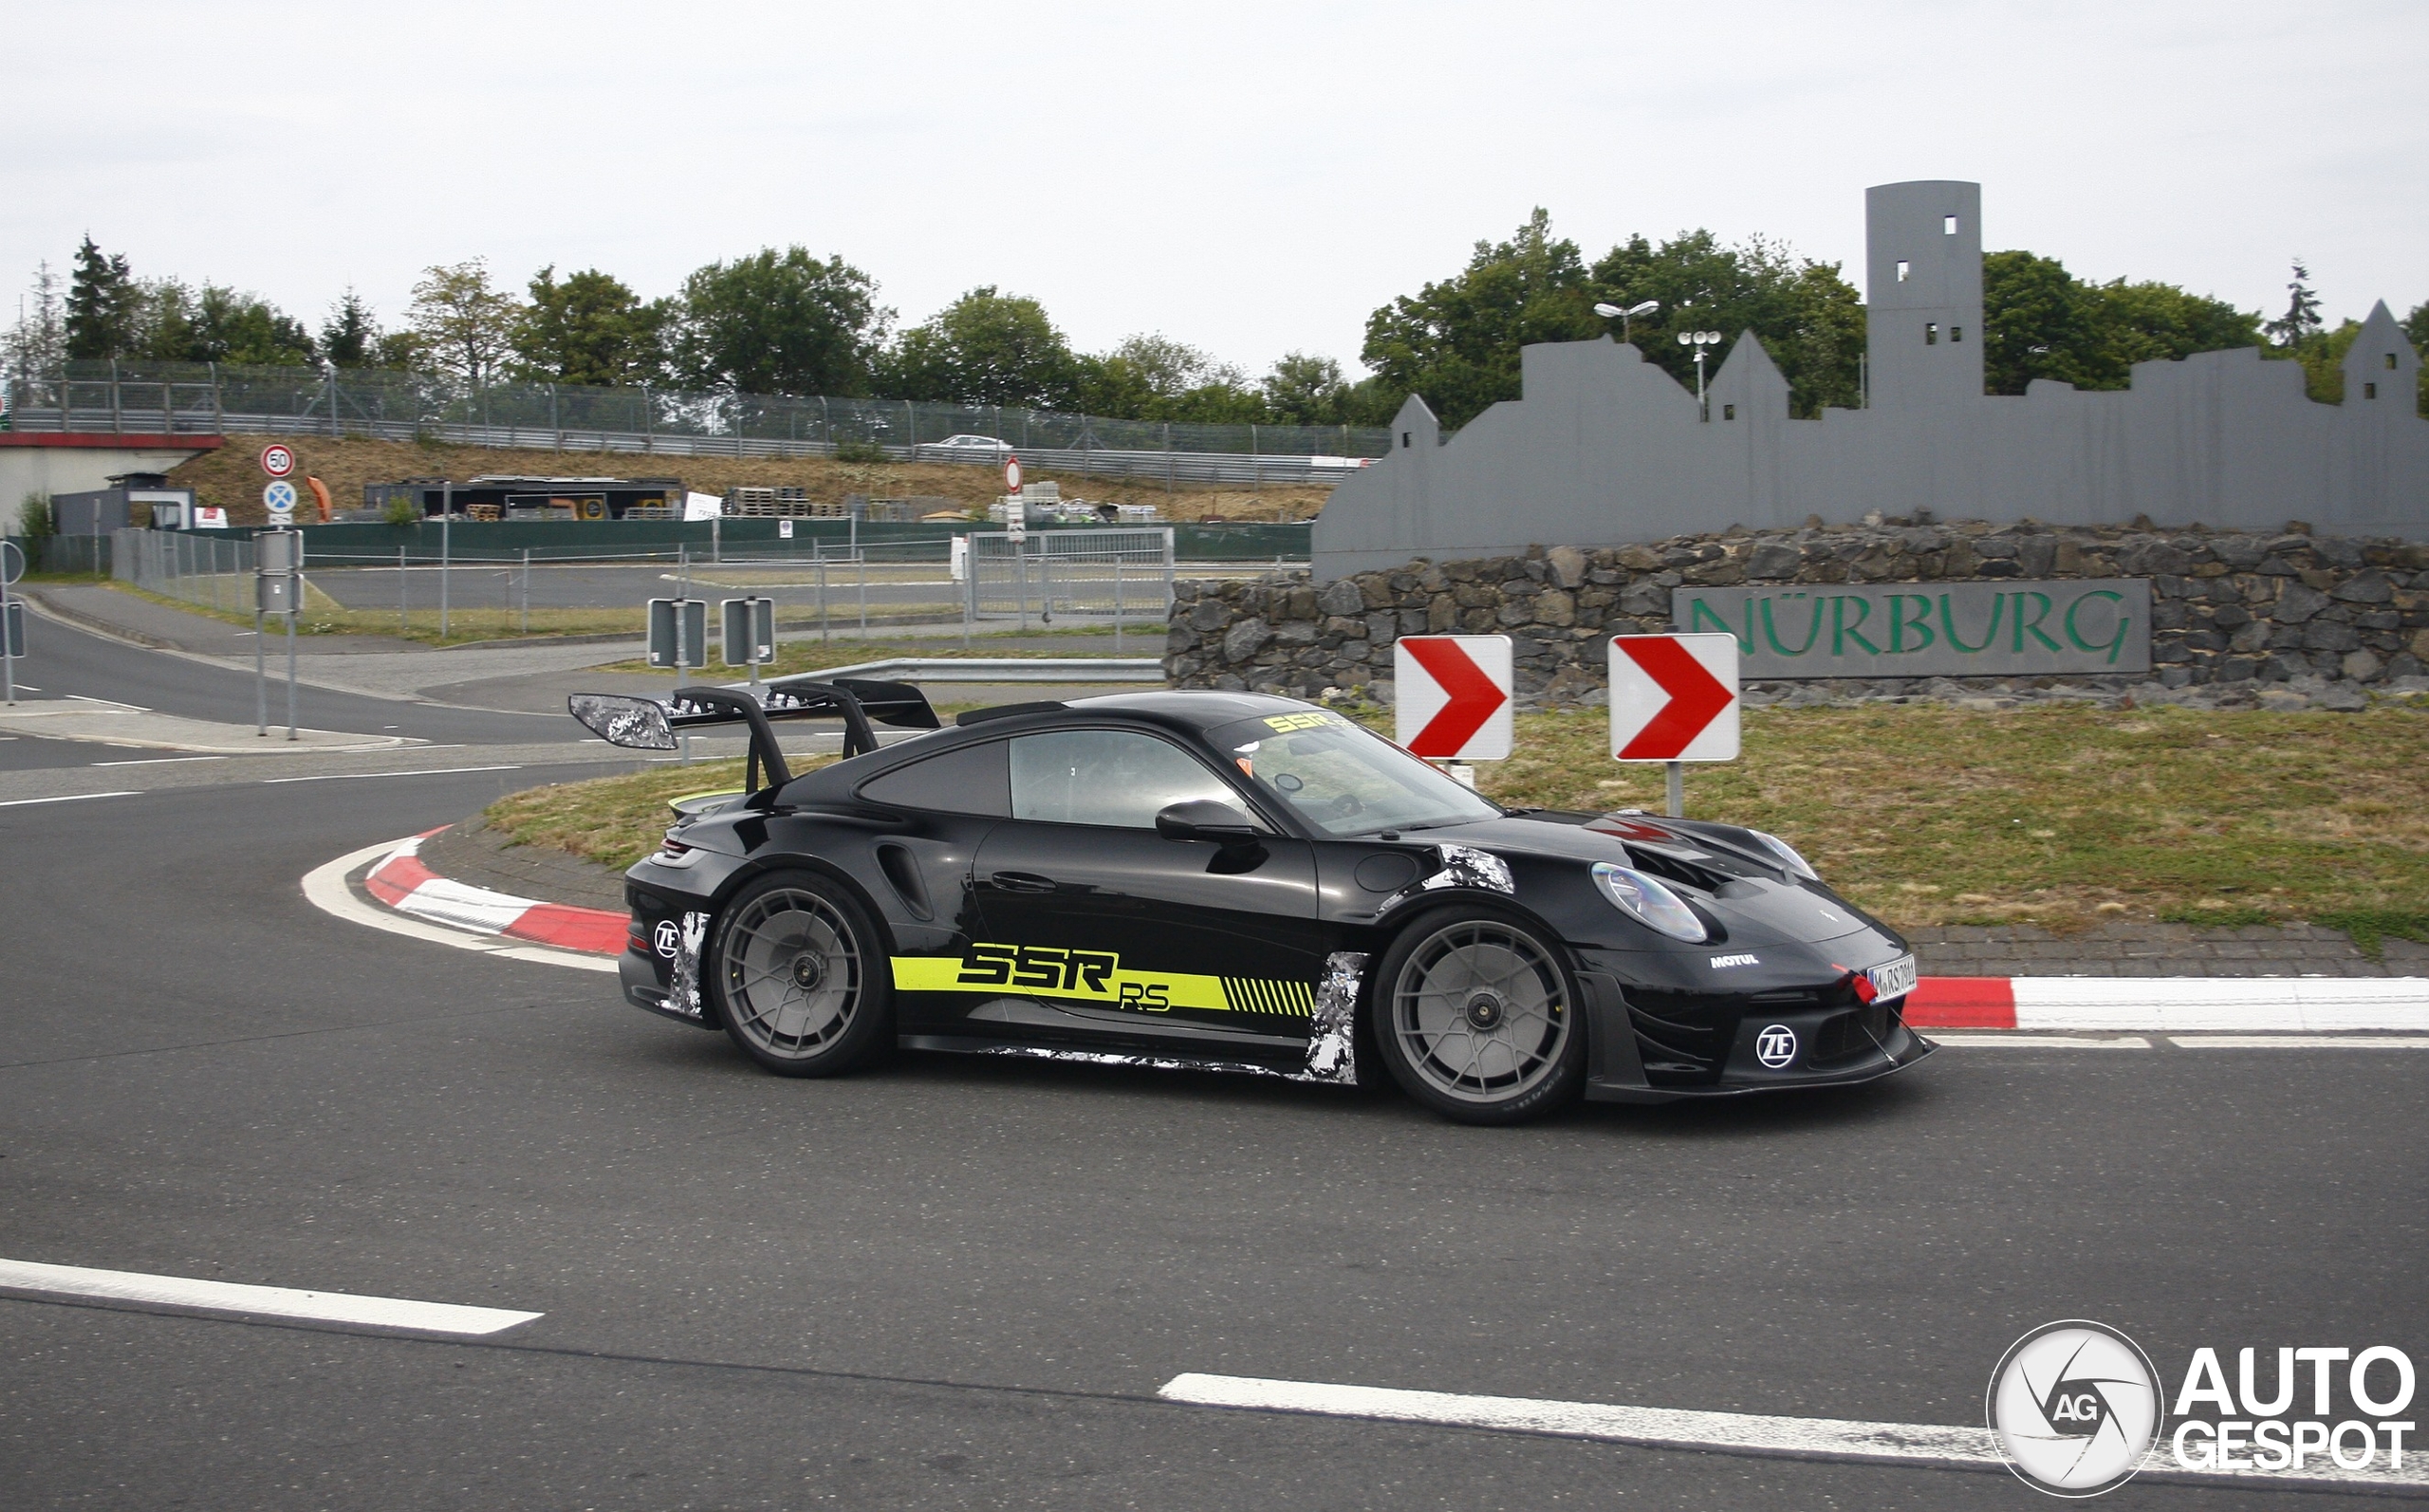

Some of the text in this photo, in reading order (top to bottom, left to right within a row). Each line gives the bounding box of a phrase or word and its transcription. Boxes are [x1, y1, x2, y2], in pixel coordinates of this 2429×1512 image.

[269, 453, 287, 468] 50
[1691, 590, 2130, 664] NÜRBURG
[1263, 713, 1335, 733] SSR
[656, 927, 679, 951] ZF
[1710, 954, 1759, 968] MOTUL
[956, 943, 1171, 1011] SSR RS
[1757, 1032, 1795, 1060] ZF
